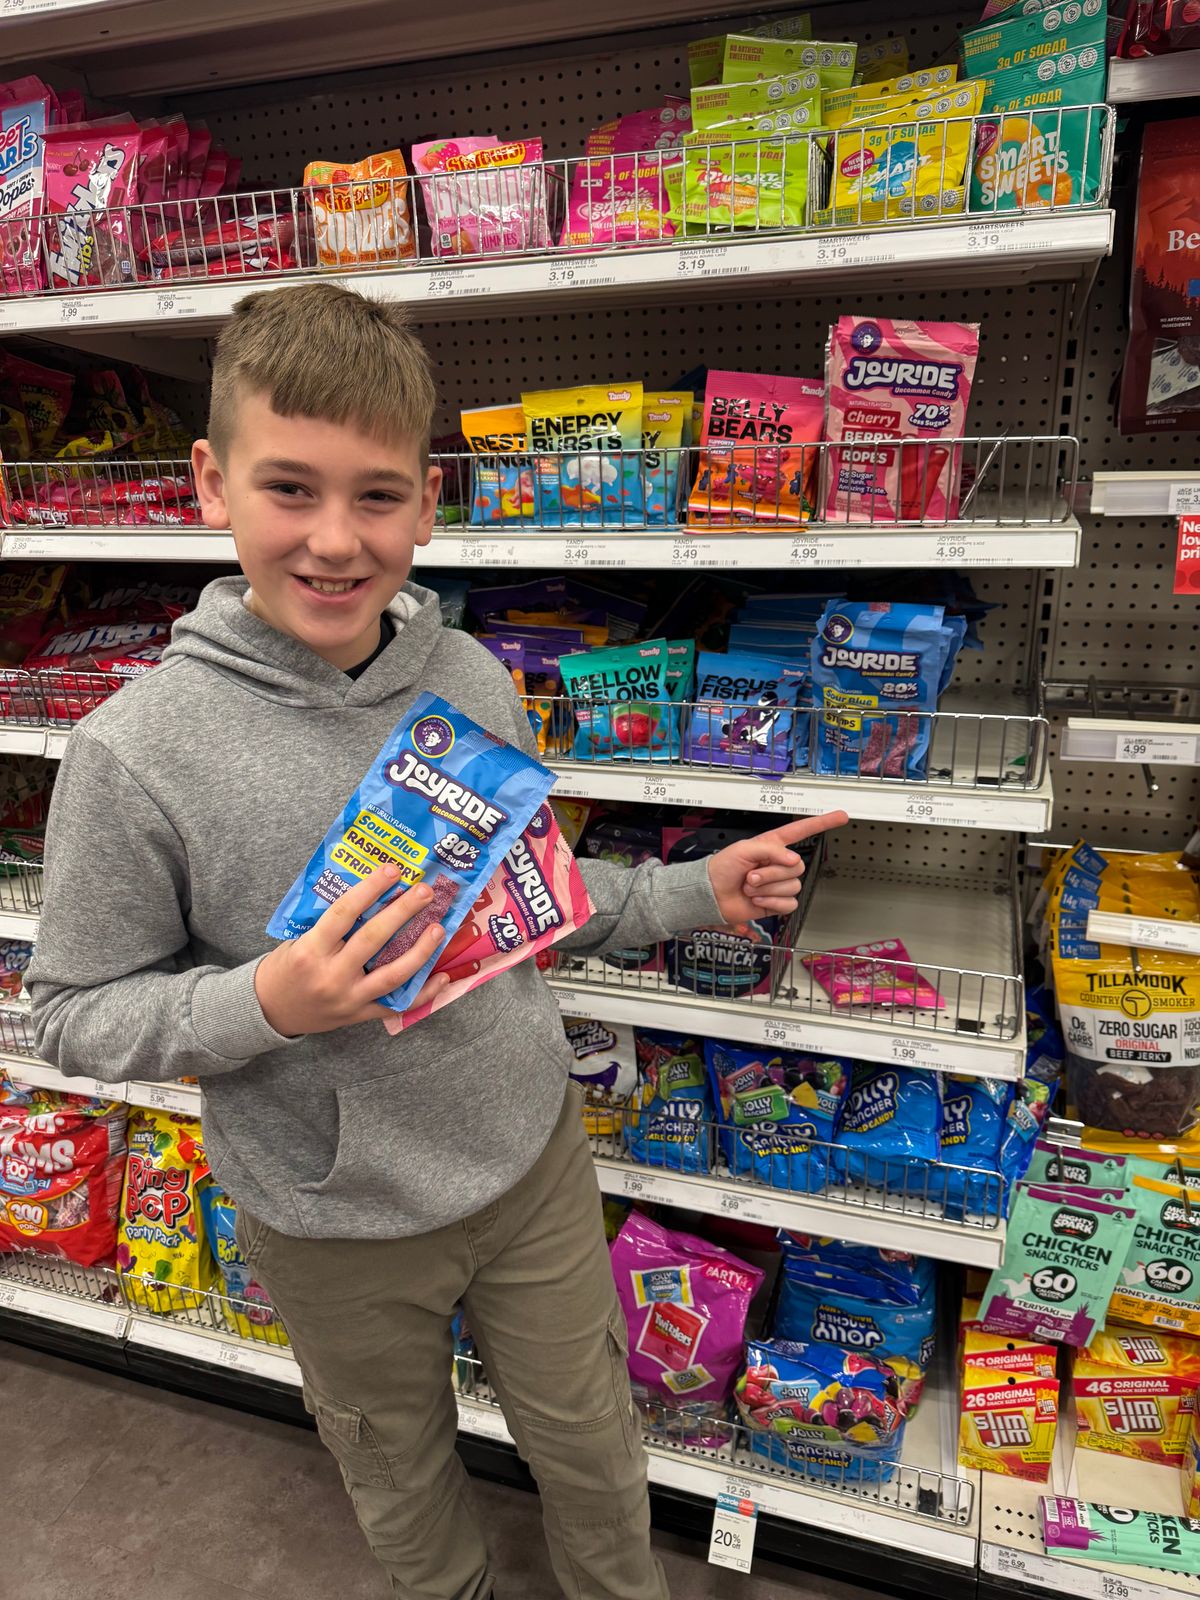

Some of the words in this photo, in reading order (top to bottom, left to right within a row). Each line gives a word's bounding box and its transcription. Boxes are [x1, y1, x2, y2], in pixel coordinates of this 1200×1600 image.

[1014, 48, 1026, 64] OF
[1029, 38, 1067, 59] SUGAR
[1009, 98, 1021, 111] OF
[1024, 88, 1062, 106] SUGAR
[870, 136, 882, 146] 3g
[980, 131, 1058, 181] SMART
[980, 151, 1069, 206] SWEETS
[968, 222, 1024, 231] SMARTSWEETS
[818, 236, 870, 244] SMARTSWEETS
[968, 234, 999, 246] 3.19
[680, 247, 728, 256] SMARTSWEETS
[817, 248, 846, 259] 3.19
[550, 258, 595, 266] SMARTSWEETS
[678, 260, 705, 270] 3.19
[549, 270, 574, 280] 3.19
[428, 280, 452, 290] 2.99
[158, 300, 174, 310] 1.99
[62, 308, 77, 318] 1.99
[1168, 316, 1193, 324] ARTIFICIAL
[846, 358, 960, 391] JOYRIDE
[608, 391, 632, 402] Tandy
[894, 386, 930, 396] Uncommon
[931, 388, 954, 398] Candy
[710, 396, 790, 422] BELLY
[914, 404, 951, 418] 70%
[531, 412, 623, 437] ENERGY
[846, 410, 896, 428] Cherry
[908, 416, 924, 426] Less
[707, 418, 793, 444] BEARS
[842, 450, 889, 464] ROPES
[1183, 521, 1200, 532] Ne
[461, 549, 483, 558] 3.49
[565, 549, 588, 559] 3.49
[673, 549, 697, 559] 3.49
[791, 548, 818, 559] 4.99
[936, 547, 965, 557] 4.99
[1180, 548, 1200, 560] pri
[640, 647, 661, 658] Tandy
[822, 646, 917, 672] JOYRIDE
[570, 664, 662, 693] MELLOW
[704, 674, 778, 690] FOCUS
[700, 682, 750, 700] FISH
[826, 689, 846, 702] Sour
[848, 697, 872, 706] Blue
[1123, 744, 1146, 754] 4.99
[390, 753, 504, 833] JOYRIDE
[644, 786, 666, 796] 3.49
[760, 794, 784, 804] 4.99
[907, 805, 933, 816] 4.99
[368, 804, 394, 822] NATURALLY
[392, 816, 416, 838] FLAVORED
[431, 804, 468, 830] Uncommon
[467, 822, 488, 840] Candy
[358, 814, 390, 842] Sour
[389, 833, 420, 860] Blue
[433, 844, 448, 860] Less
[441, 832, 480, 860] 80%
[334, 848, 374, 878] STRIP
[318, 876, 328, 886] No
[323, 868, 333, 880] 4g
[508, 880, 528, 917] Uncommon
[526, 916, 538, 938] Candy
[1062, 894, 1078, 910] 14g
[489, 914, 498, 932] Less
[496, 912, 524, 947] 70%
[692, 930, 752, 950] COSMIC
[684, 944, 758, 967] CRUNCH
[1061, 944, 1079, 956] 14g
[1086, 972, 1187, 996] TILLAMOOK
[1080, 992, 1120, 1006] COUNTRY
[1152, 996, 1196, 1008] SMOKER
[764, 1029, 786, 1040] 1.99
[1098, 1019, 1130, 1038] ZERO
[1133, 1021, 1178, 1040] SUGAR
[1068, 1031, 1094, 1047] CARBS
[1115, 1039, 1161, 1052] ORIGINAL
[893, 1048, 915, 1059] 1.99
[1109, 1048, 1136, 1060] BEEF
[1137, 1050, 1169, 1062] JERKY
[151, 1095, 165, 1104] 5.99
[744, 1097, 772, 1110] JOLLY
[844, 1074, 895, 1119] JOLLY
[941, 1134, 966, 1146] ANDY
[128, 1156, 187, 1193] Ring
[624, 1182, 642, 1192] 1.99
[721, 1200, 739, 1210] 4.69
[10, 1204, 42, 1224] 300
[1058, 1212, 1094, 1228] MIGHTY
[18, 1223, 40, 1234] POPS
[1053, 1219, 1094, 1234] SPARK
[126, 1226, 154, 1241] Party
[154, 1232, 181, 1247] Pack
[1023, 1232, 1112, 1266] CHICKEN
[1136, 1240, 1174, 1257] SNACK
[1025, 1248, 1061, 1264] SNACK
[1062, 1255, 1100, 1272] STICKS
[706, 1266, 741, 1284] PARTY
[1147, 1262, 1192, 1285] 60
[1033, 1269, 1076, 1294] 60
[1114, 1286, 1148, 1299] HONEY
[1018, 1300, 1060, 1316] TERIYAKI
[816, 1322, 882, 1348] JOLLY
[1118, 1336, 1160, 1352] slim
[219, 1351, 238, 1361] 11.99
[986, 1354, 1034, 1366] ORIGINAL
[1132, 1348, 1165, 1364] jim
[781, 1386, 810, 1399] JOLLY
[1086, 1382, 1112, 1394] 46
[1114, 1380, 1170, 1388] ORIGINAL
[966, 1394, 986, 1408] 26
[986, 1388, 1036, 1401] ORIGINAL
[1104, 1397, 1159, 1416] slim
[767, 1408, 795, 1420] JOLLY
[974, 1412, 1028, 1430] slim
[1115, 1416, 1162, 1434] jim
[790, 1427, 826, 1438] JOLLY
[986, 1429, 1032, 1448] jim
[725, 1484, 751, 1498] 12.59
[714, 1529, 741, 1547] 20%
[1011, 1559, 1025, 1569] 6.99
[1103, 1584, 1128, 1598] 12.99
